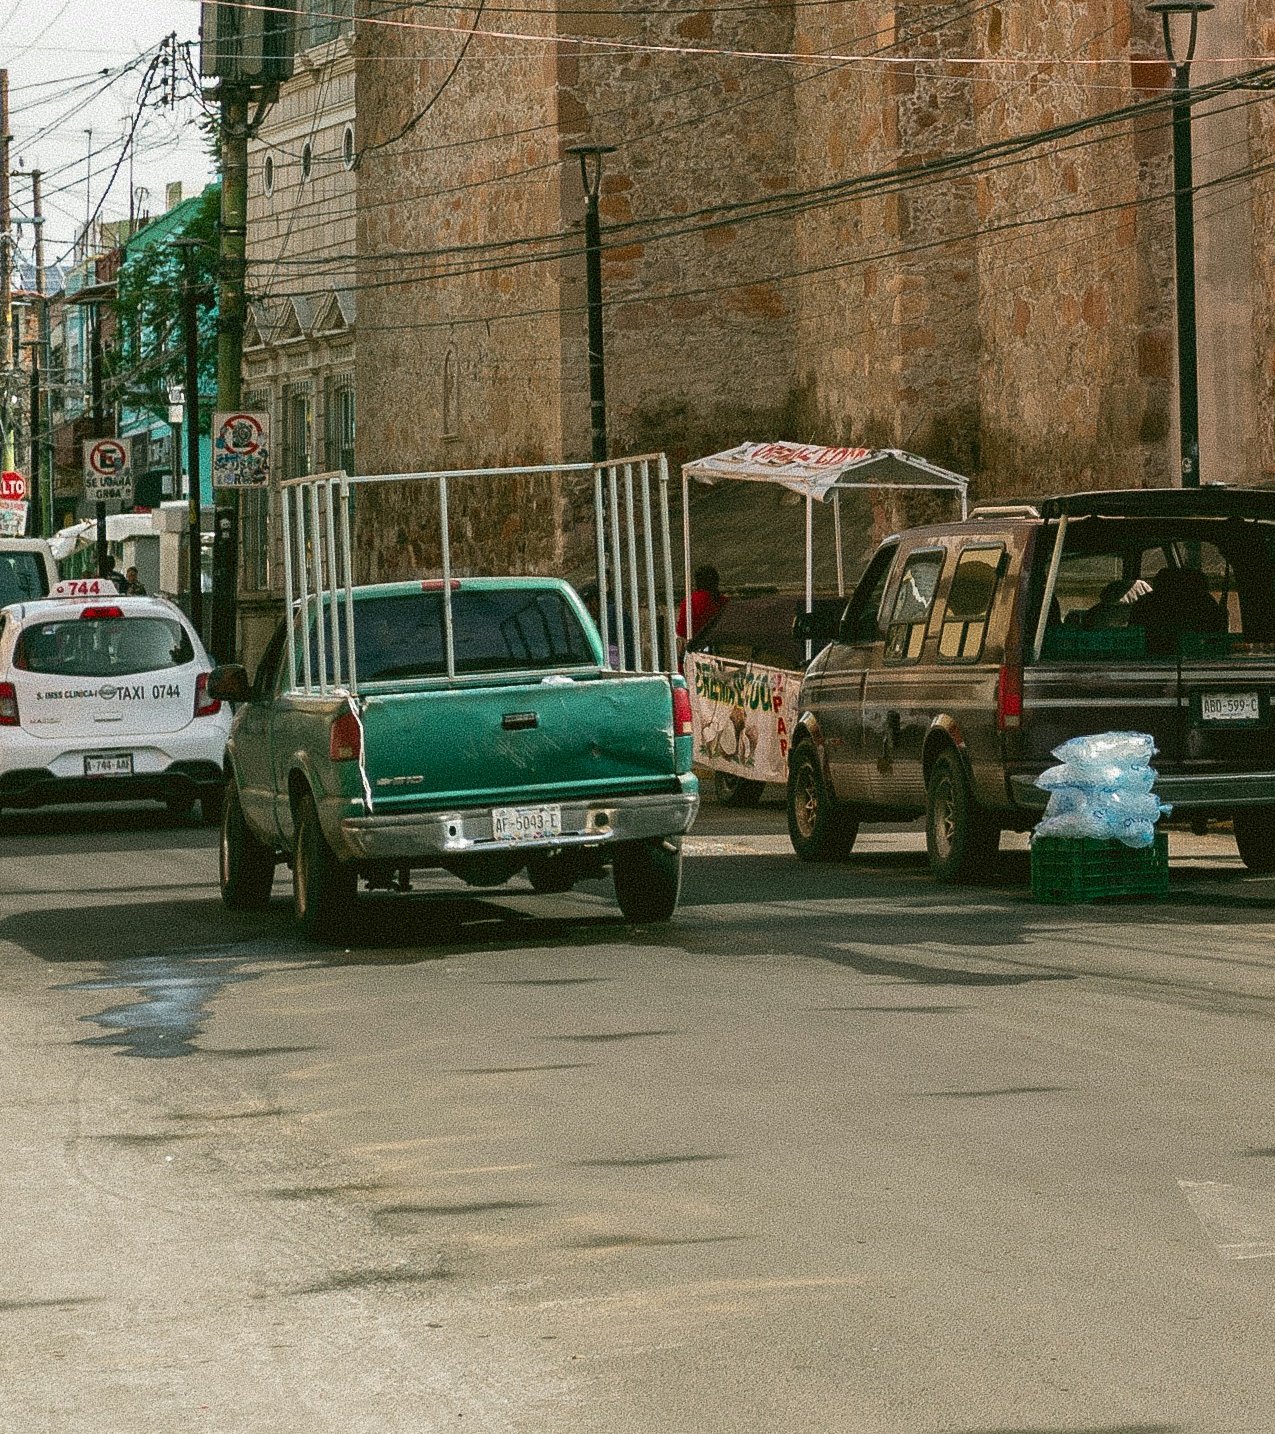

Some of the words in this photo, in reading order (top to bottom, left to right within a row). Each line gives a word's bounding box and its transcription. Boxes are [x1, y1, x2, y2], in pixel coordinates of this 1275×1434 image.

[0, 479, 24, 495] LTO
[69, 580, 100, 595] 744
[117, 686, 145, 701] TAXI
[152, 684, 180, 699] 0744
